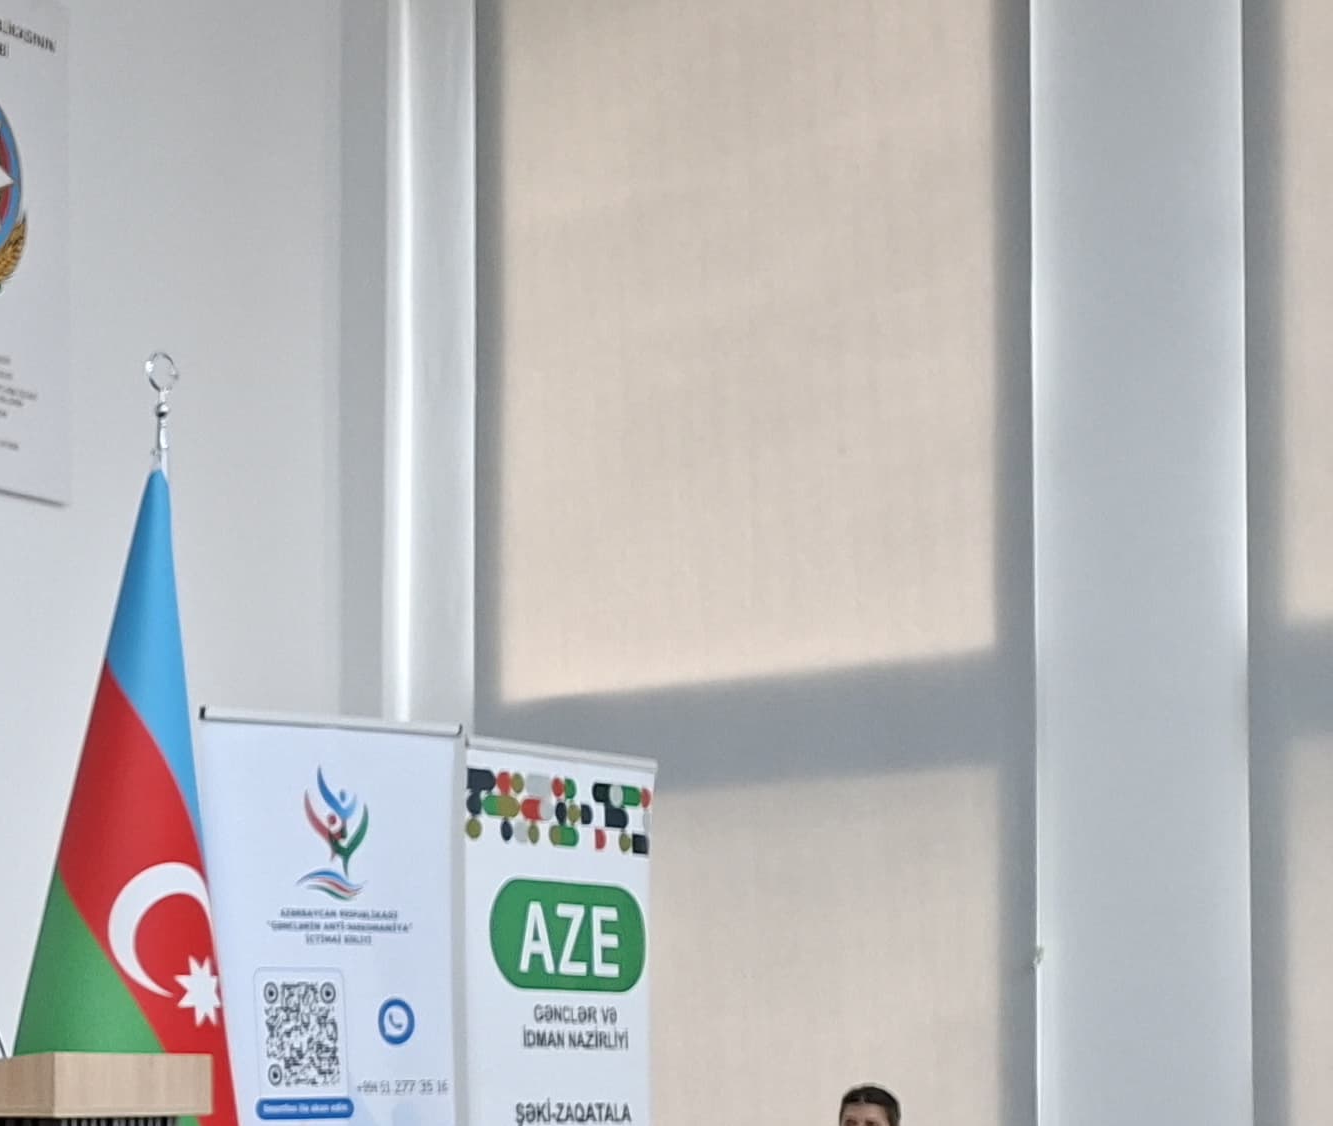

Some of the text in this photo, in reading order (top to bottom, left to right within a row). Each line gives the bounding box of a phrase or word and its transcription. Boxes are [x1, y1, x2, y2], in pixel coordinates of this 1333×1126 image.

[519, 900, 620, 978] AZE
[533, 1003, 618, 1025] GƏNCLƏR VƏ
[523, 1025, 629, 1049] İDMAN NAZİRLİYİ
[515, 1098, 632, 1126] ŞƏKİ-ZAQATALA
